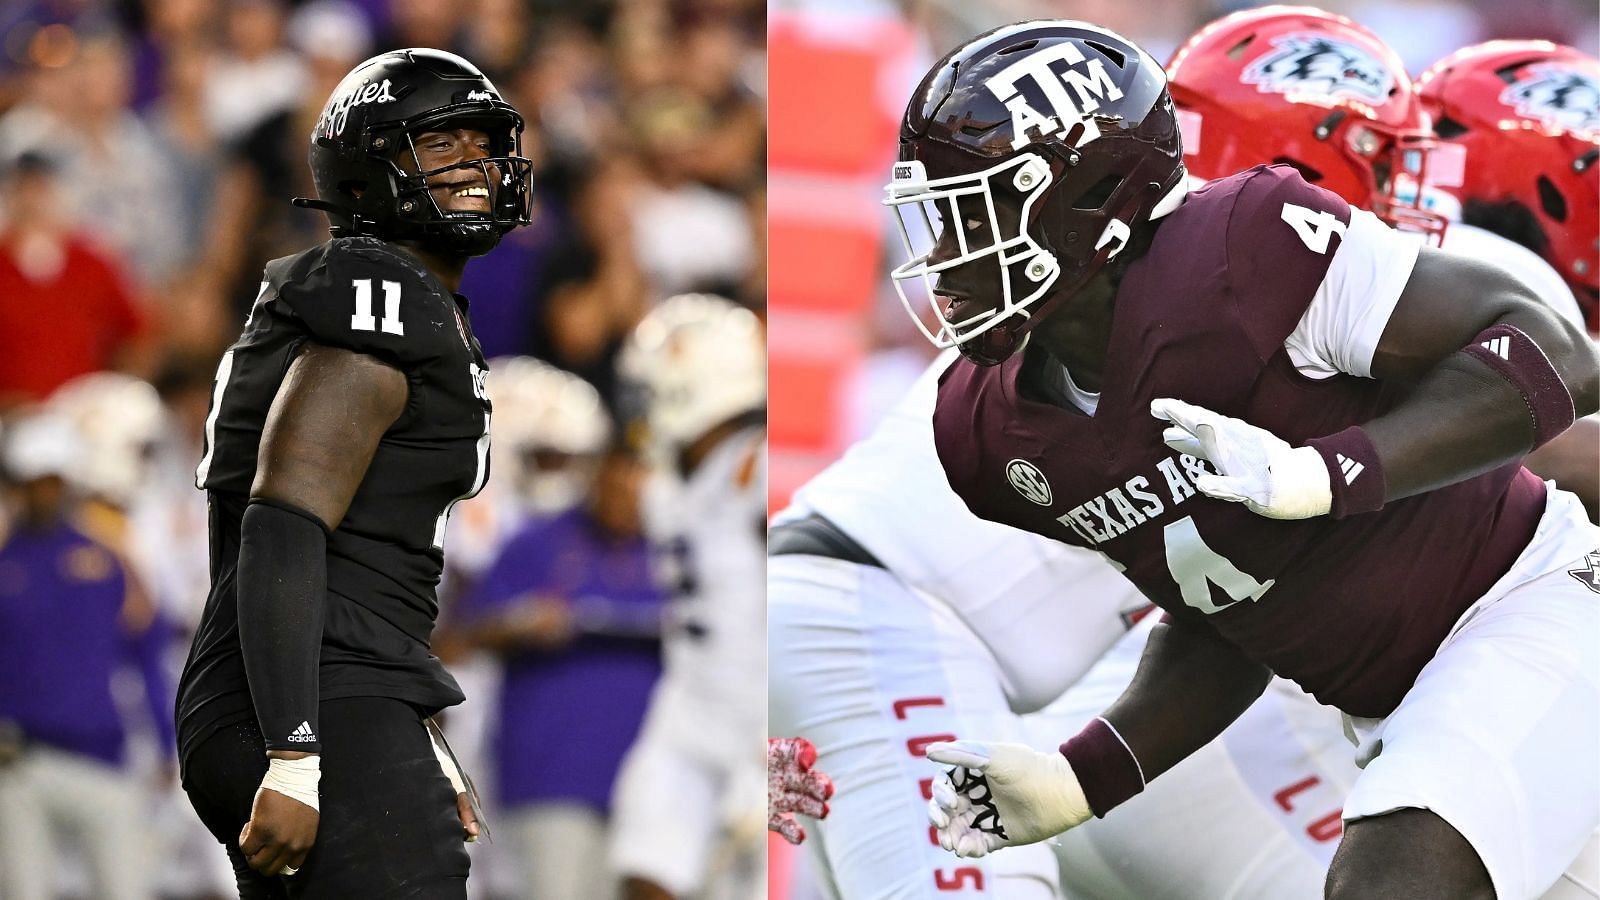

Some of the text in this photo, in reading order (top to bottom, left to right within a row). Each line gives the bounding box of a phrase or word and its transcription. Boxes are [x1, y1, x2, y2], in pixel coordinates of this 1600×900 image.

[1280, 202, 1347, 255] 4
[351, 279, 404, 336] 11
[1009, 463, 1050, 503] SEC
[1055, 475, 1165, 550] TEXAS
[1163, 515, 1276, 615] 4
[287, 734, 317, 743] adidas
